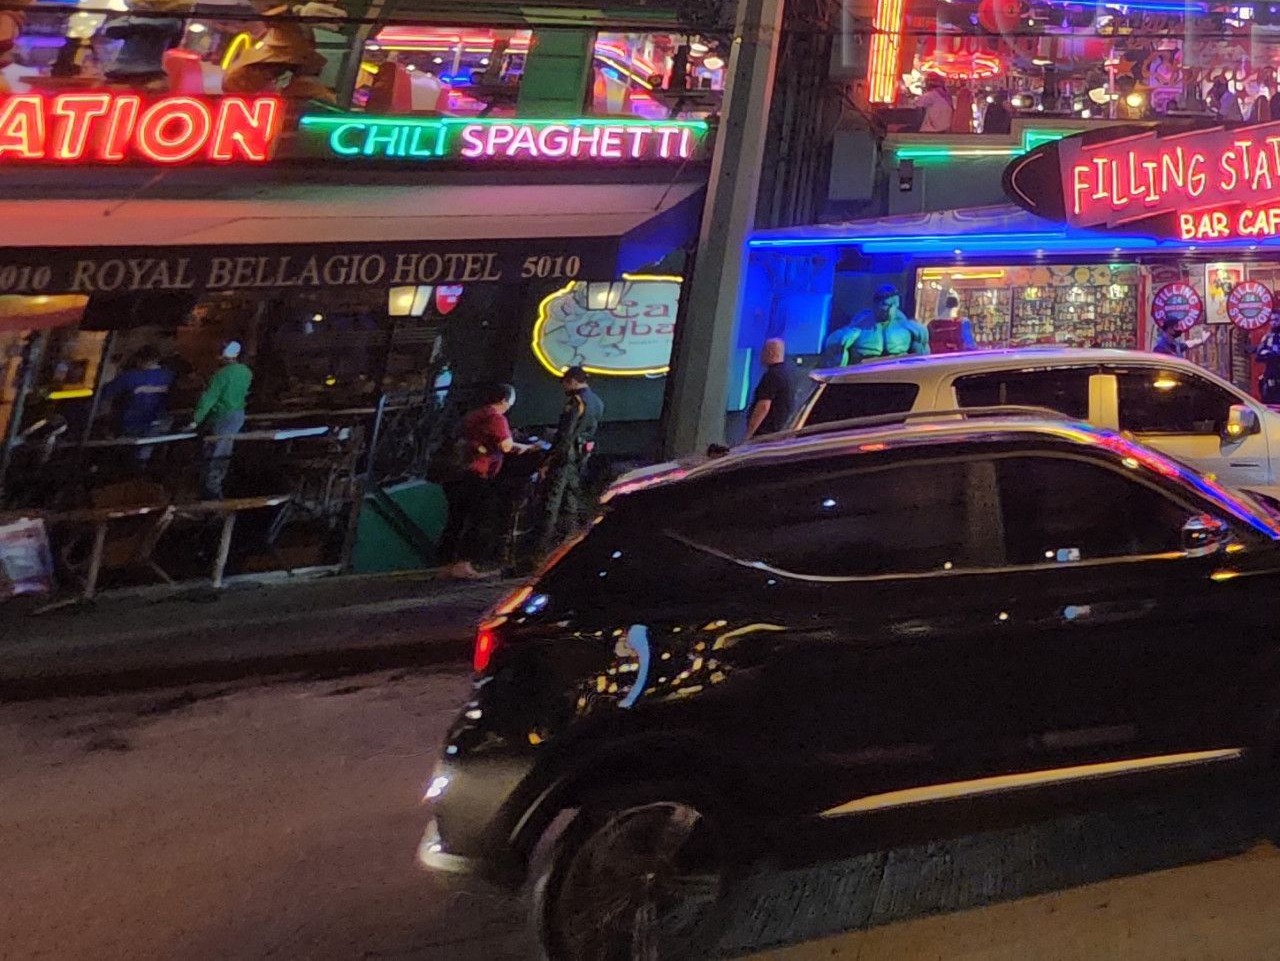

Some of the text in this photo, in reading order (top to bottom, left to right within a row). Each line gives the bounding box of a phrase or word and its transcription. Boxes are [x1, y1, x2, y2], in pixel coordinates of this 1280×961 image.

[331, 123, 691, 158] CHILI SPAGHETTI
[1074, 146, 1206, 215] FILLING
[1180, 212, 1230, 239] BAR
[71, 258, 197, 290] ROYAL
[206, 254, 386, 288] BELLAGIO
[390, 252, 501, 284] HOTEL
[521, 255, 581, 278] 5010
[1155, 284, 1199, 307] FILLING
[1230, 283, 1271, 304] FILLING
[1155, 309, 1200, 331] SION
[1230, 307, 1272, 328] STATION
